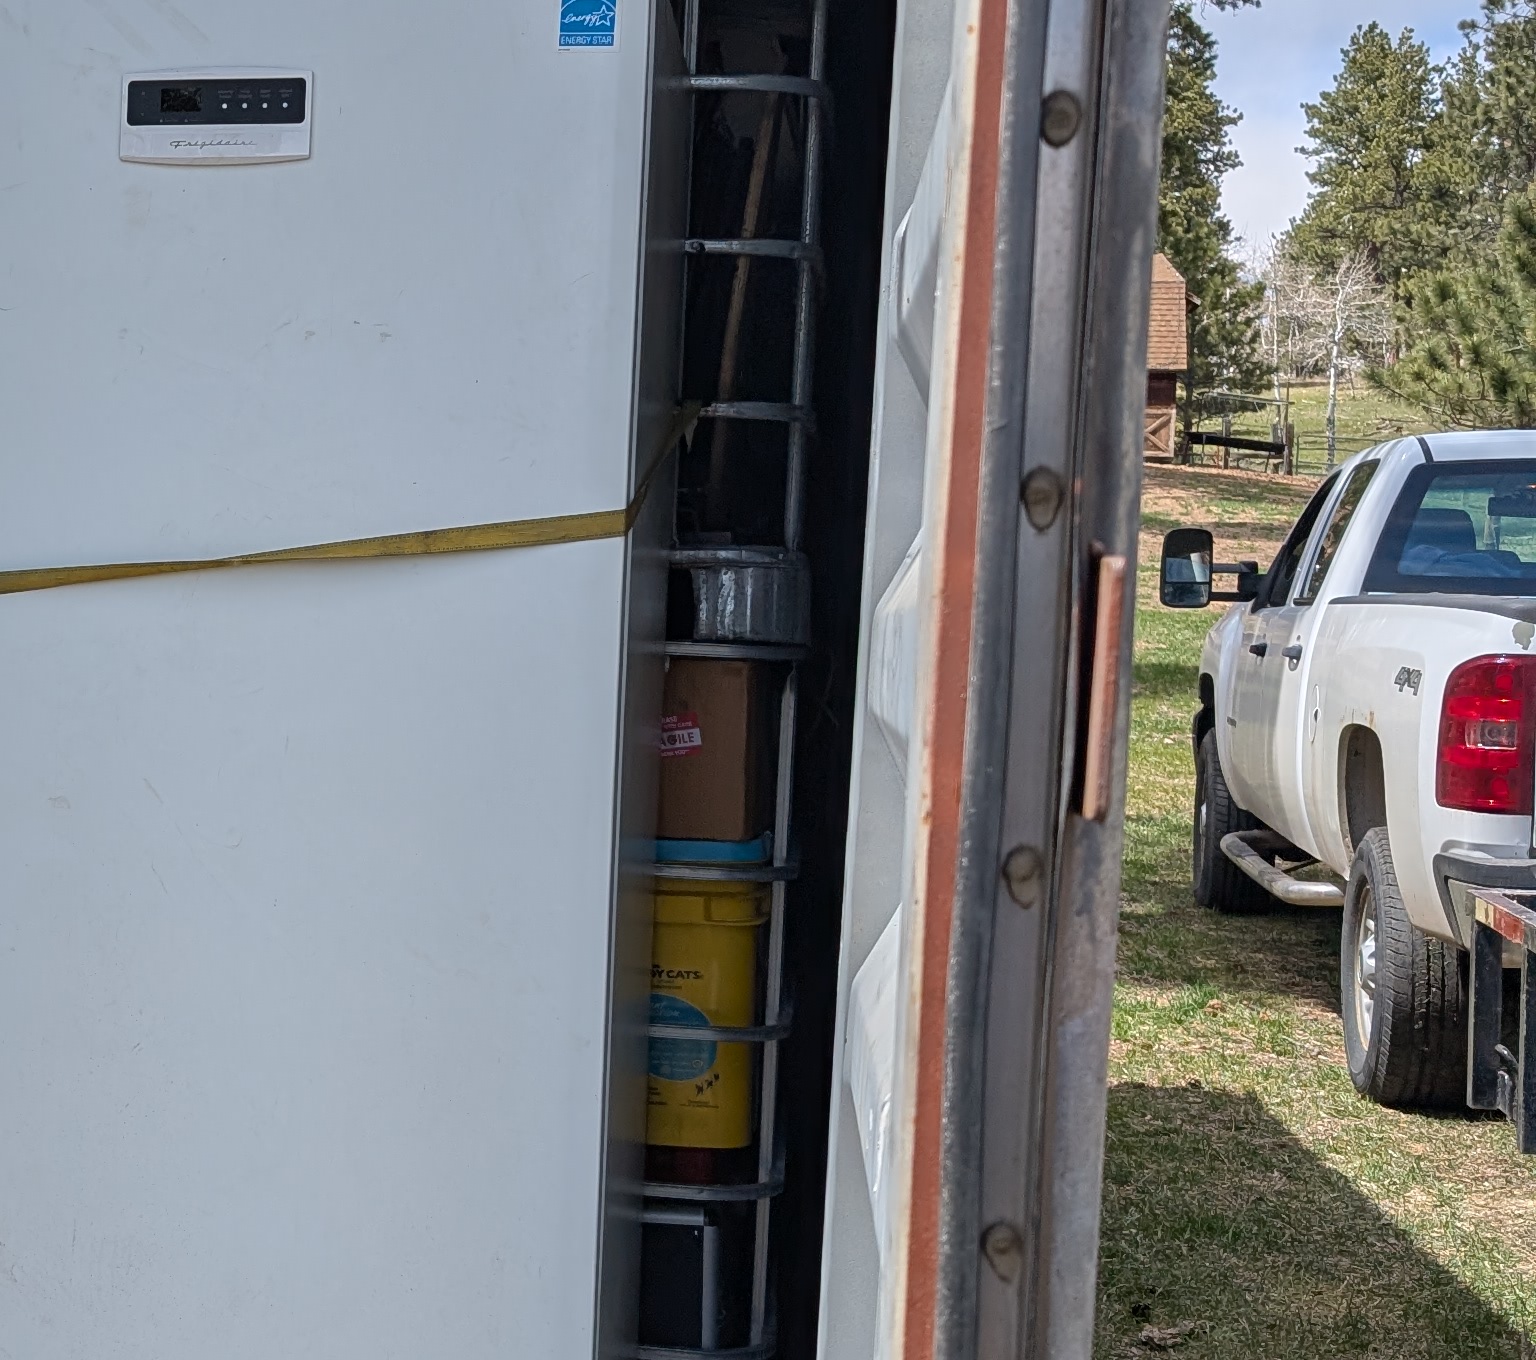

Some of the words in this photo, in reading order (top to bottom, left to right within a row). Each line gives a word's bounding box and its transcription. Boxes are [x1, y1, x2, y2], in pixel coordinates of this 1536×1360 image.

[560, 35, 591, 45] ENERGY
[592, 35, 613, 45] STAR
[665, 968, 702, 980] CATS
